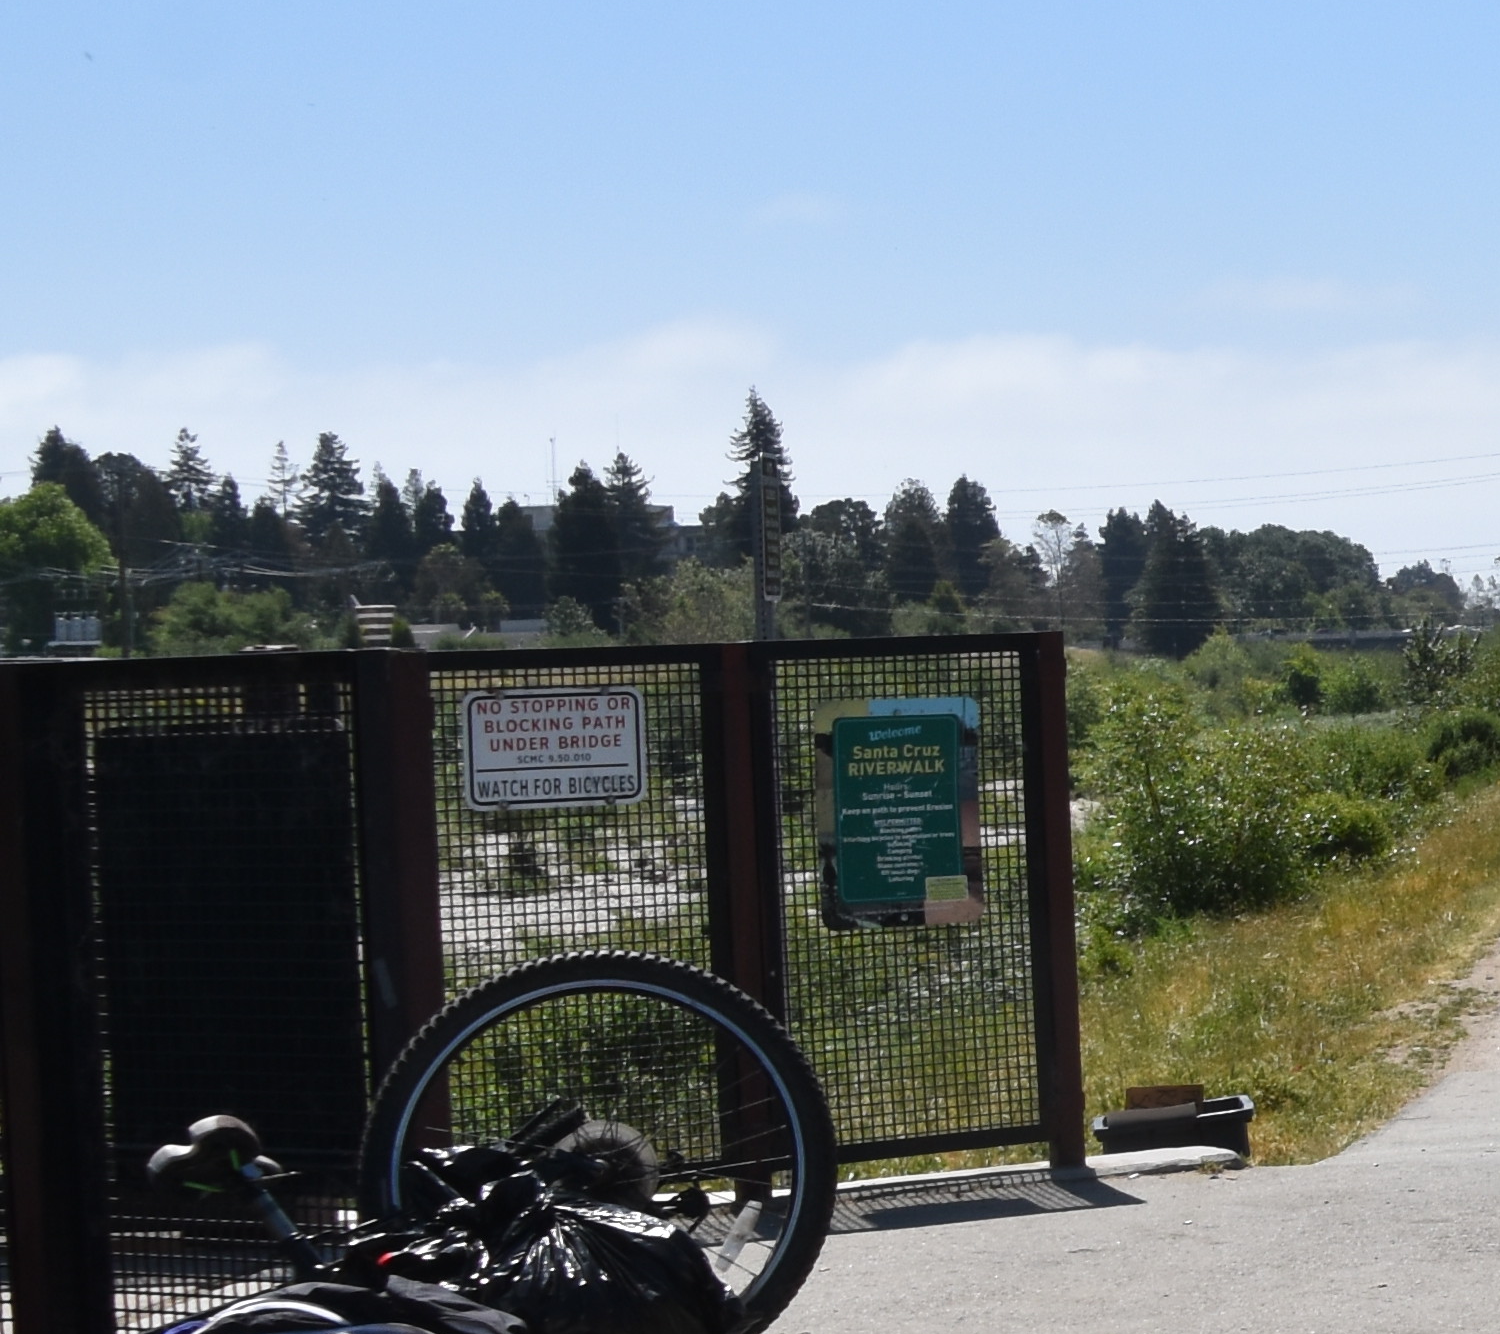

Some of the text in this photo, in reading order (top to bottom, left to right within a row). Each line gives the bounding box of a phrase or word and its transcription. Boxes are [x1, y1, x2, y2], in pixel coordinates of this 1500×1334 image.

[476, 697, 630, 715] NO STOPPING OR
[484, 716, 626, 734] BLOCKING PATH
[868, 725, 922, 742] Welcome
[490, 734, 622, 752] UNDER BRIDGE
[853, 744, 940, 760] Santa Cruz
[517, 754, 545, 764] SCMC
[848, 759, 945, 777] RIVERWALK
[478, 775, 635, 798] WATCH FOR BICYCLES
[862, 792, 895, 801] Sunrise
[903, 790, 932, 799] Sunset
